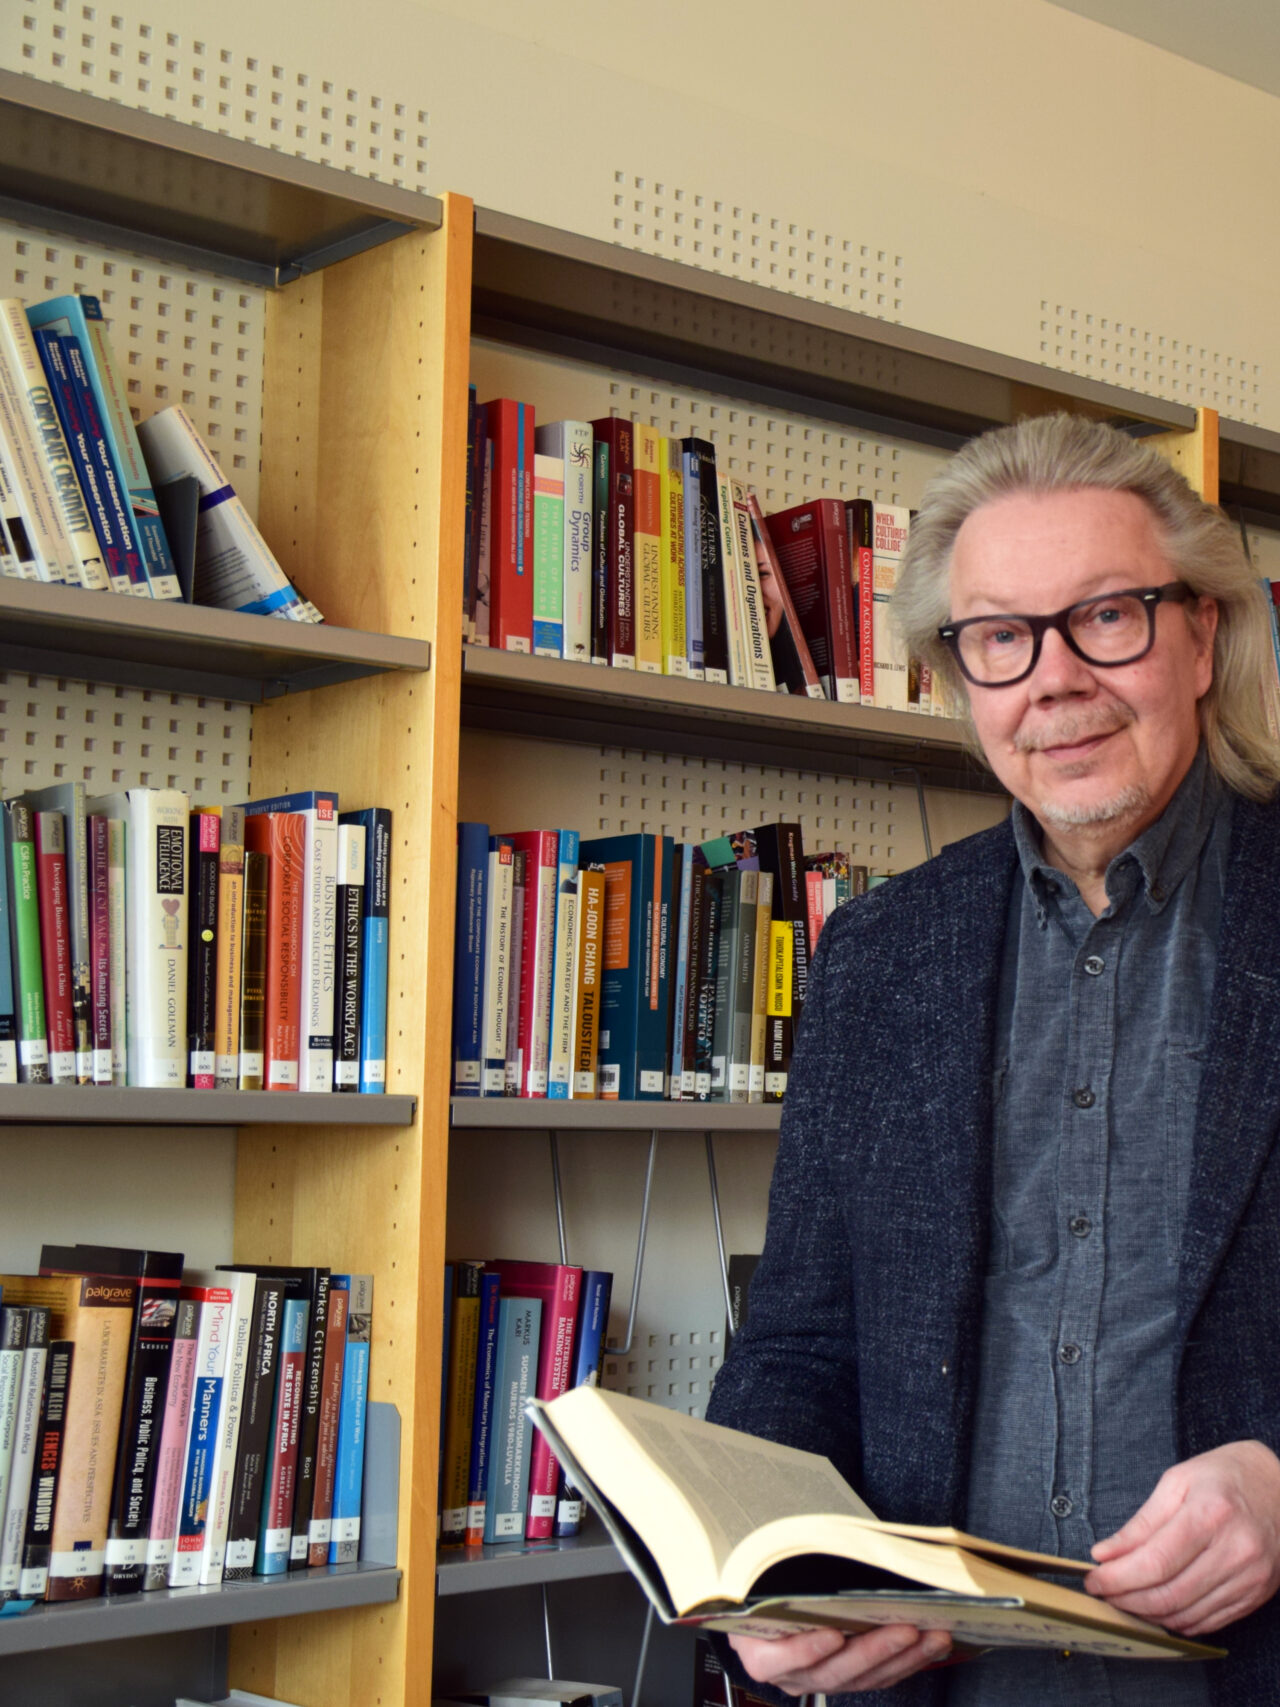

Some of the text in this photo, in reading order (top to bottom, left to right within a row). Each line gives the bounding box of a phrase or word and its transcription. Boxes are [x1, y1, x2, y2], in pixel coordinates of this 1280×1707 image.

[27, 384, 92, 536] CORPORATE CREATIVITY
[75, 432, 114, 545] Your Dissertation
[568, 510, 582, 572] Dynamics
[578, 511, 591, 553] Group
[876, 512, 895, 526] WHEN
[876, 525, 907, 541] CULTURES
[876, 537, 901, 552] COLLIDE
[617, 504, 625, 616] GLOBAL CULTURES
[736, 512, 764, 660] Cultures and Organizations
[862, 551, 871, 645] CONFLICT ACROSS
[19, 845, 31, 900] CSR in Practice
[49, 862, 62, 905] Developing
[158, 829, 170, 890] INTELLIGENCE
[170, 829, 183, 891] EMOTIONAL
[281, 835, 292, 897] CORPORATE
[53, 906, 63, 938] Business
[279, 900, 290, 938] SOCIAL
[322, 874, 335, 992] BUSINESS ETHICS
[584, 887, 599, 940] HA-JOON
[659, 915, 667, 946] CULTURAL
[54, 938, 65, 962] Ethics
[56, 963, 65, 972] in
[96, 851, 108, 1041] THE ART OF WAR Its Amazing Secrets
[343, 887, 359, 1056] ETHICS IN THE WORKPLACE
[494, 905, 507, 1042] THE HISTORY OF ECONOMIC THOUGHT
[561, 899, 574, 1053] ECONOMICS, STRATEGY AND THE FIRM
[583, 942, 596, 985] CHANG
[658, 948, 667, 978] ECONOMY
[772, 935, 784, 1011] TUHOKAPITALISMIN NOUSU
[793, 919, 809, 1001] economics
[56, 973, 66, 997] China
[166, 958, 176, 1047] DANIEL GOLEMAN
[279, 941, 290, 1020] RESPONSIBILITY
[85, 1287, 132, 1300] palgrave
[208, 1304, 225, 1343] Mind
[264, 1290, 278, 1332] NORTH
[259, 1333, 274, 1376] AFRICA
[305, 1276, 329, 1415] Market Citizenship
[513, 1317, 522, 1337] KARI
[522, 1309, 532, 1346] MARKUS
[550, 1316, 566, 1390] BANKING SYSTEM
[45, 1351, 69, 1422] NAOMI KLEIN
[204, 1343, 220, 1376] Your
[223, 1317, 247, 1450] Publics, Politics & Power
[196, 1378, 217, 1442] Manners
[477, 1327, 495, 1467] The Economics of Monetary Integration
[124, 1375, 158, 1528] Business, Public Policy, and Society
[503, 1380, 518, 1486] MURROS 1980-LUVULLA
[510, 1354, 529, 1512] SUOMEN RAHOITUSMARKKINOIDEN
[33, 1430, 59, 1532] FENCES WINDOWS
